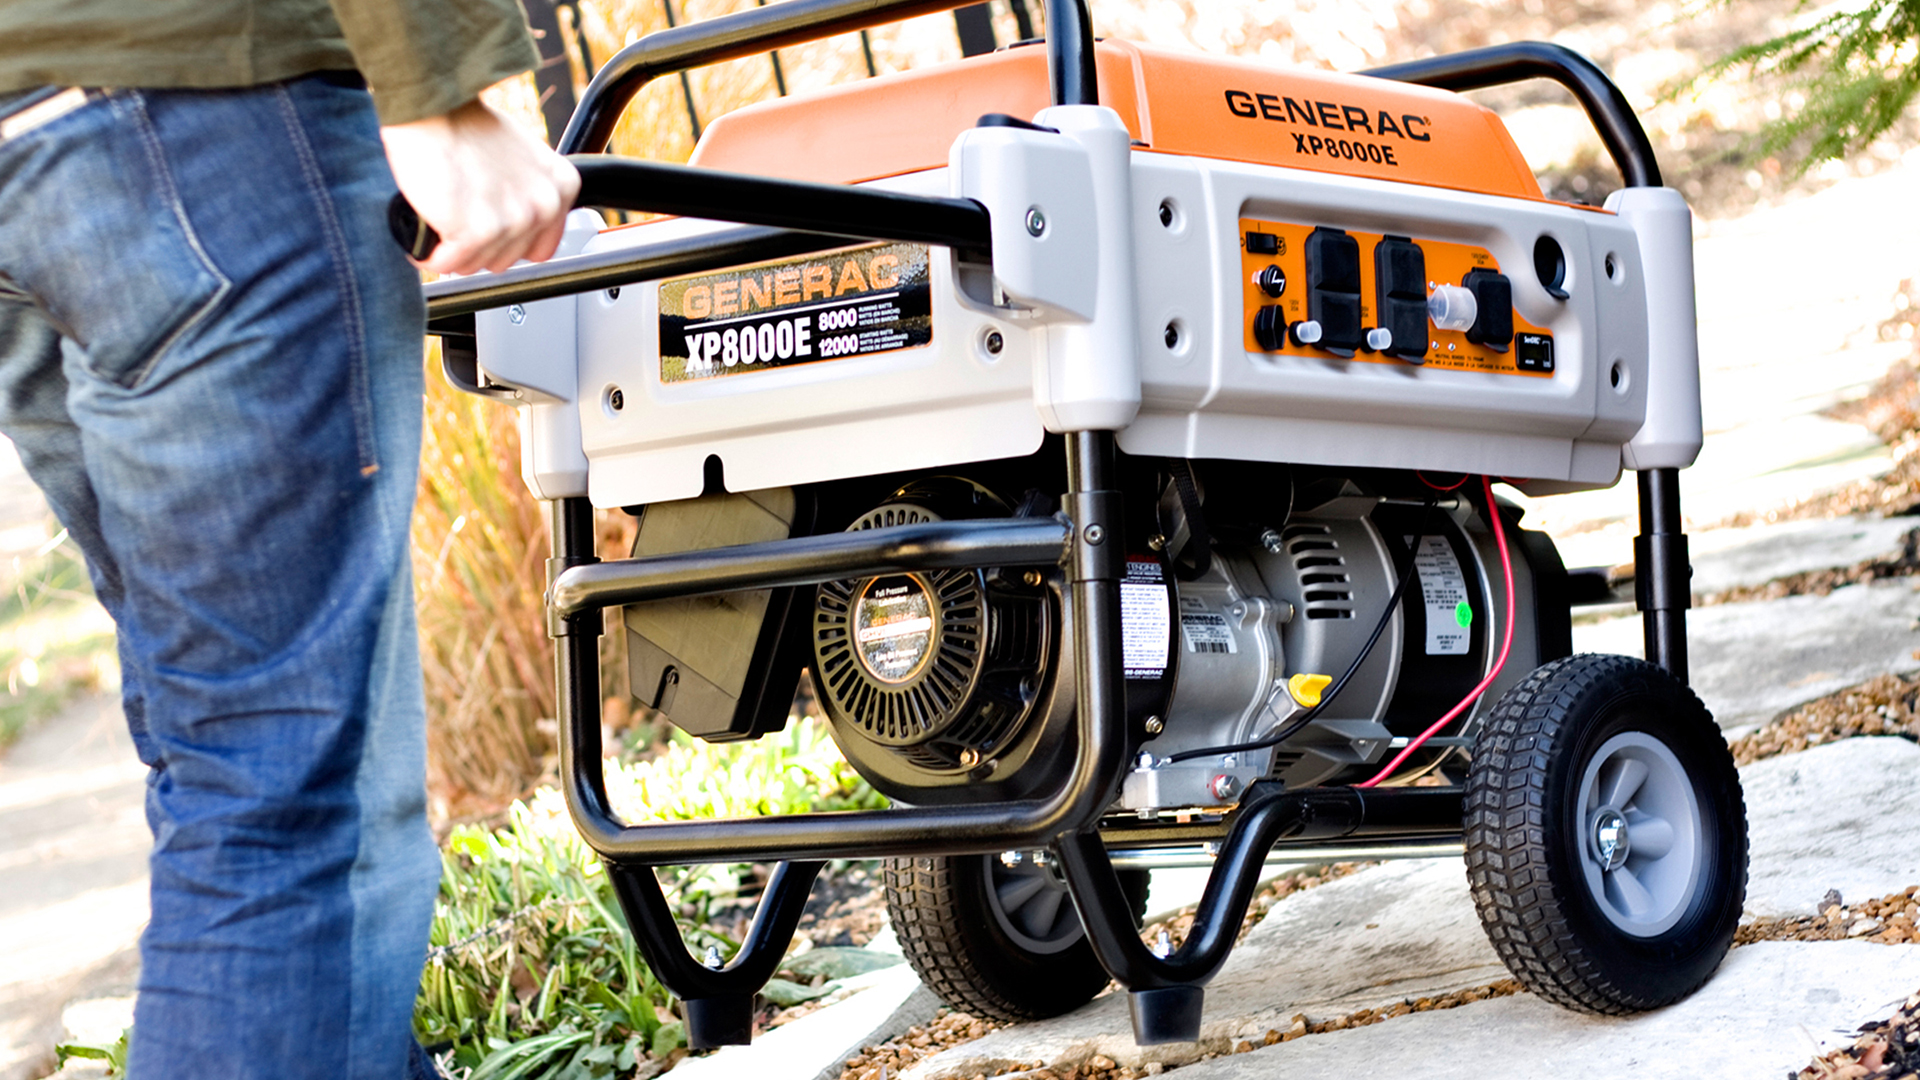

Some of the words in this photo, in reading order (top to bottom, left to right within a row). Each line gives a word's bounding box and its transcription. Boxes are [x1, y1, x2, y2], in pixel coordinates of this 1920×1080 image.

[1225, 90, 1431, 142] GENERAC
[1291, 132, 1398, 166] XP8000E
[683, 254, 900, 320] GENERAC
[818, 308, 857, 332] 8000
[685, 317, 811, 374] XP8000E
[875, 589, 885, 598] Full
[886, 586, 908, 596] Pressure
